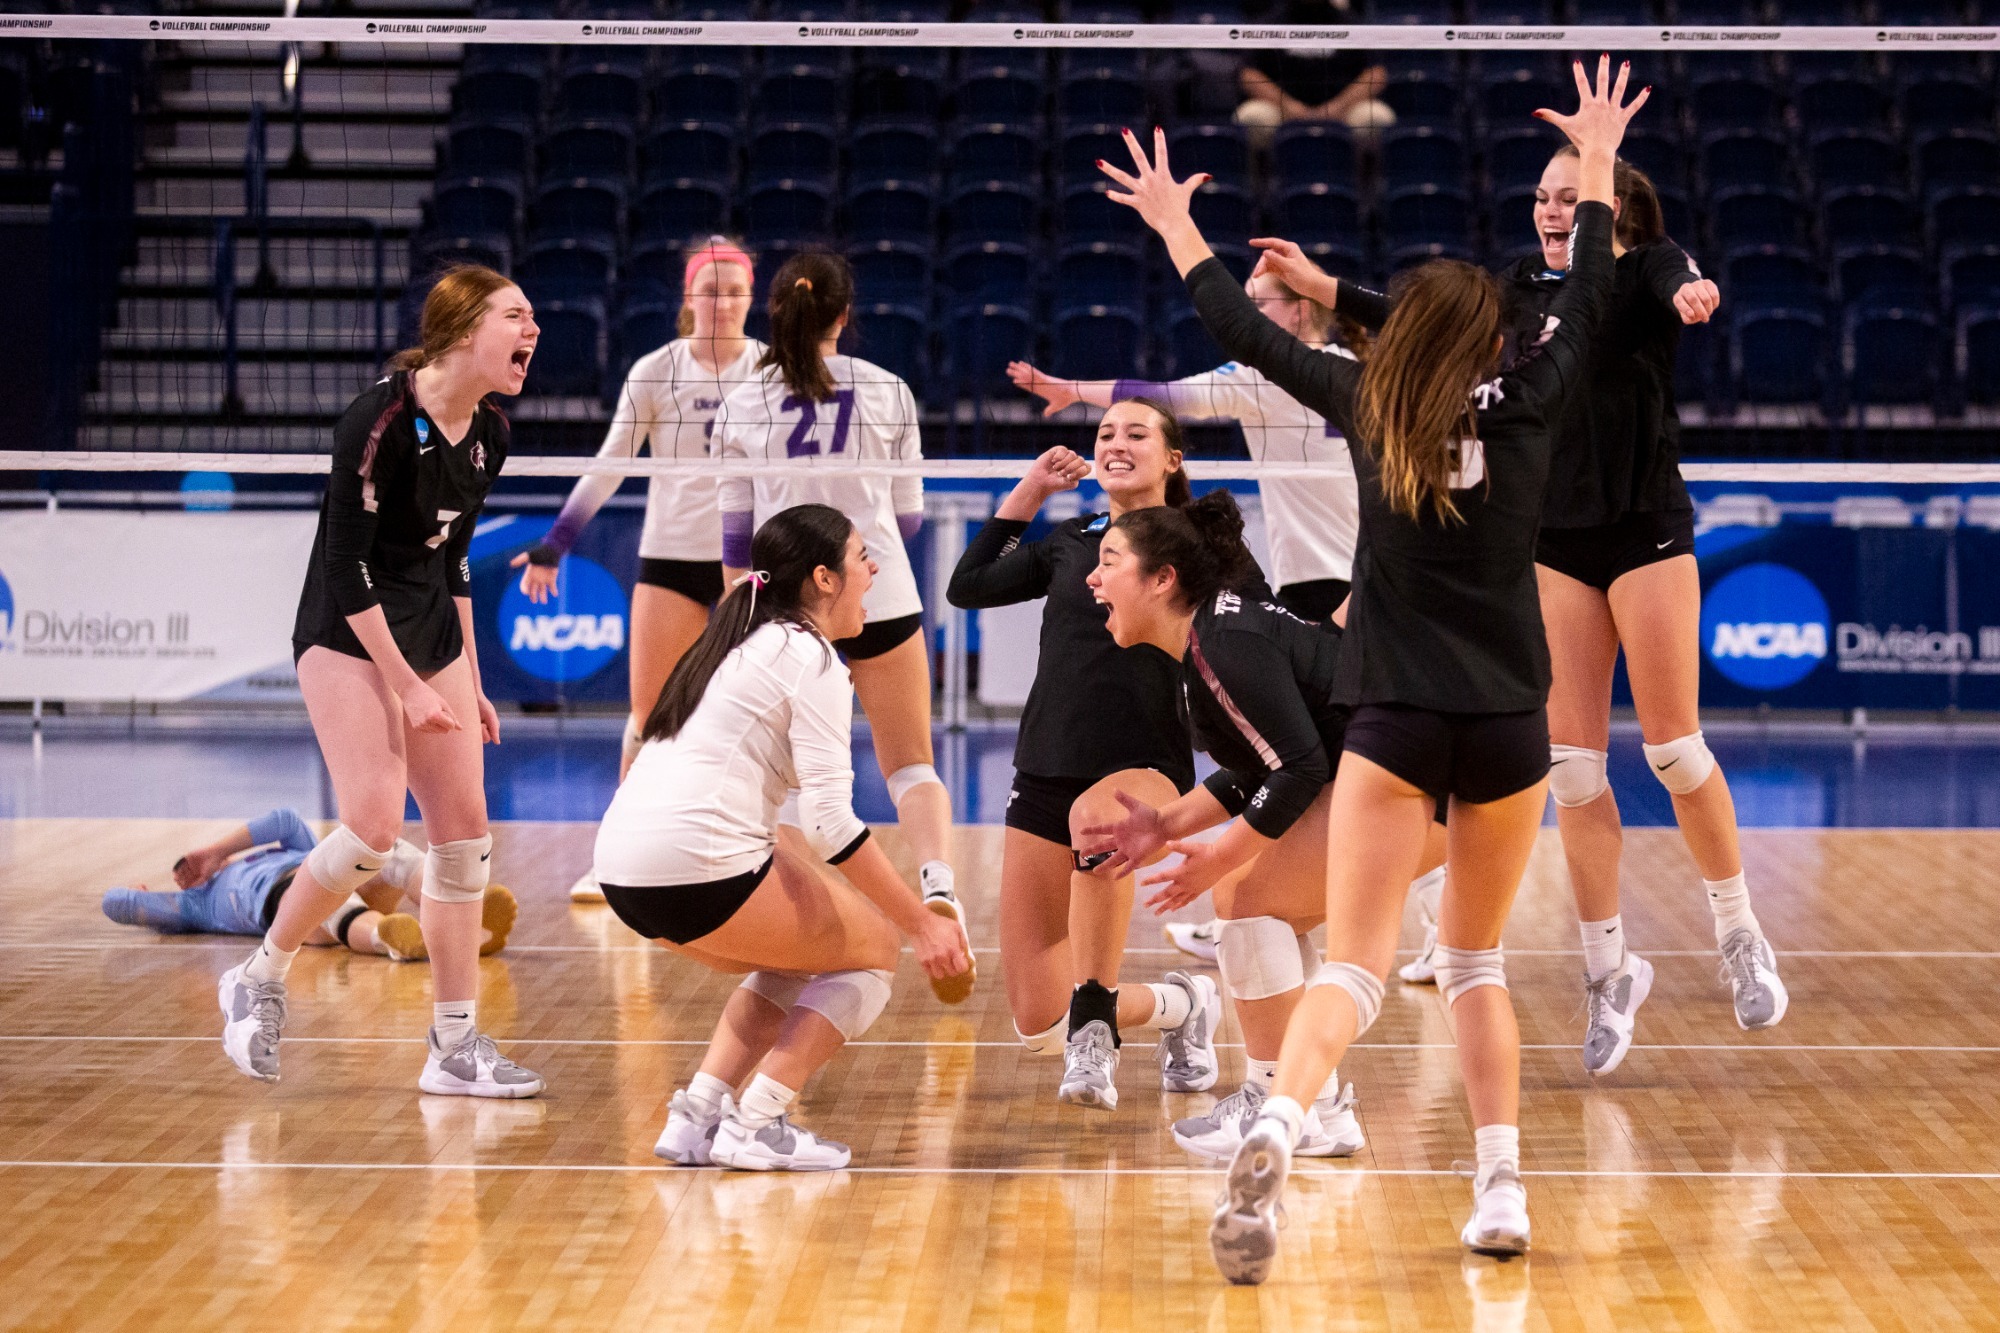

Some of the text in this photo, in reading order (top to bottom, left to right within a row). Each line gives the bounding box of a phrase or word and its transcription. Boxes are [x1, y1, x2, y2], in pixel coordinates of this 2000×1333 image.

[162, 21, 270, 32] VOLLEYBALL CHAMPIONSHIP
[379, 24, 487, 34] VOLLEYBALL CHAMPIONSHIP
[595, 26, 703, 36] VOLLEYBALL CHAMPIONSHIP
[812, 28, 920, 38] VOLLEYBALL CHAMPIONSHIP
[1027, 29, 1135, 39] VOLLEYBALL CHAMPIONSHIP
[1242, 30, 1350, 40] VOLLEYBALL CHAMPIONSHIP
[1458, 31, 1566, 41] VOLLEYBALL CHAMPIONSHIP
[780, 388, 855, 459] 27
[424, 509, 463, 550] 7
[23, 609, 190, 646] Division III
[510, 612, 626, 652] NCAA
[1711, 621, 1828, 659] NCAA
[1836, 621, 1973, 661] Division
